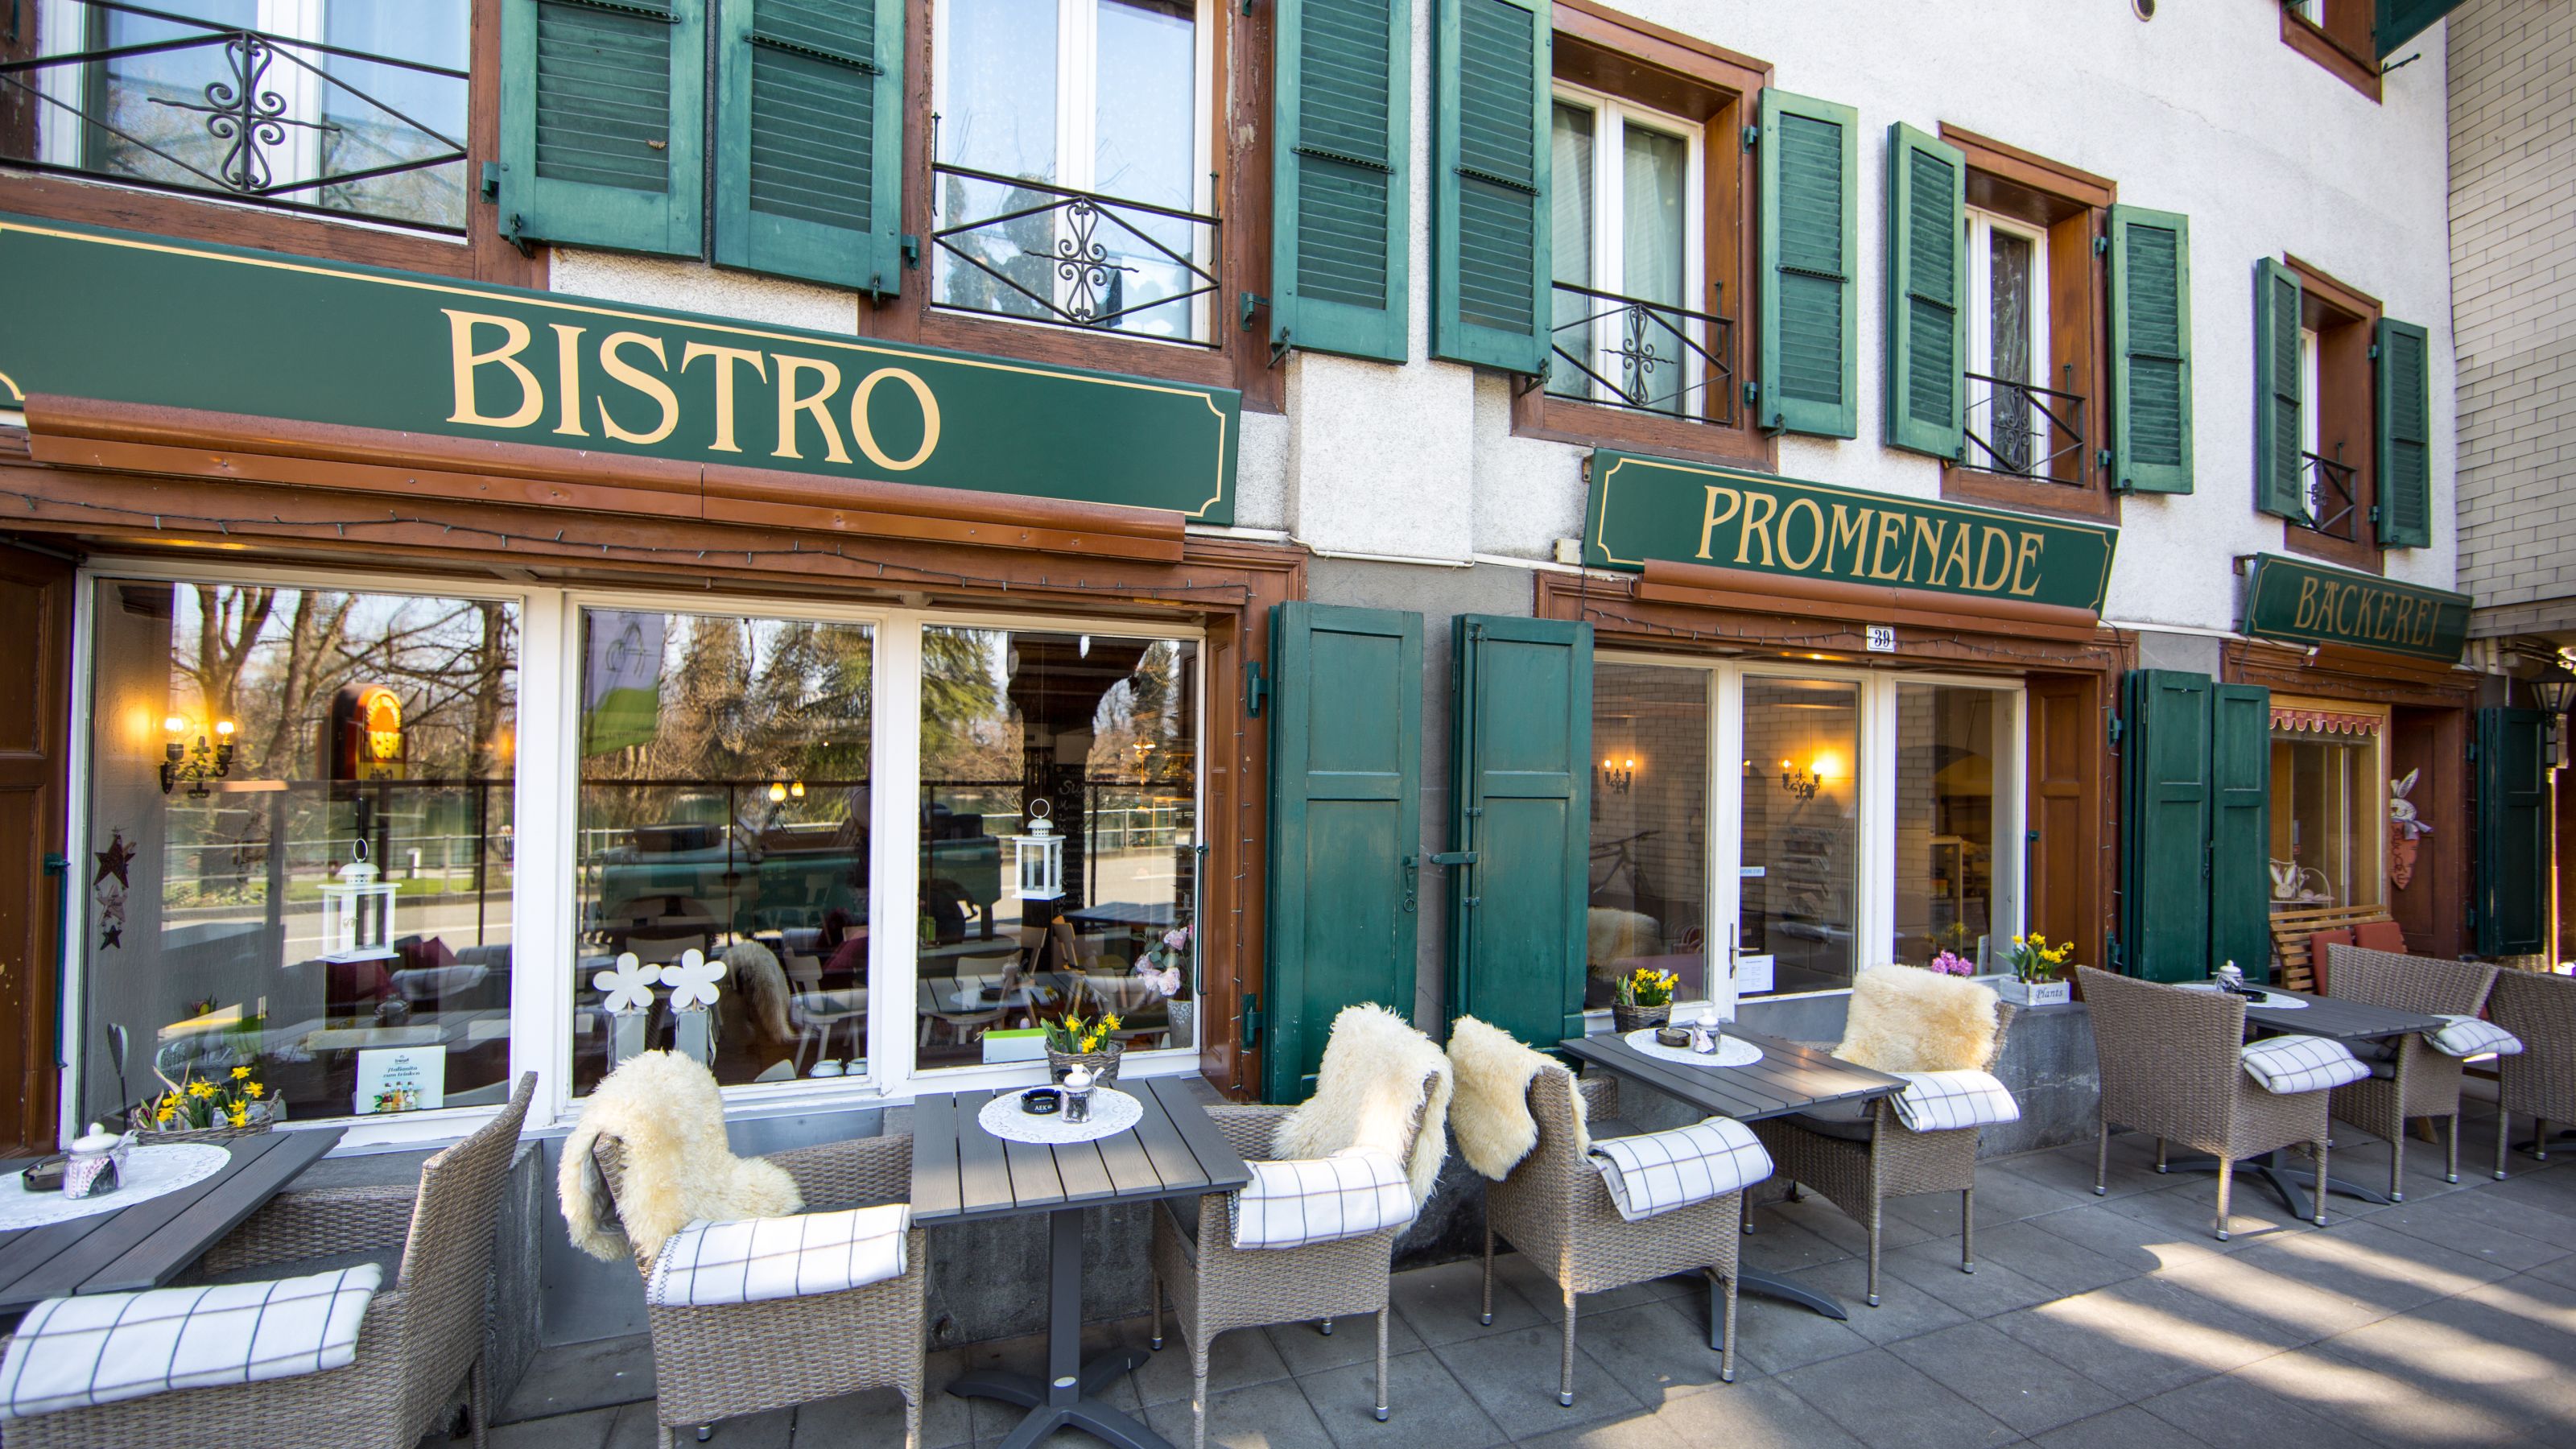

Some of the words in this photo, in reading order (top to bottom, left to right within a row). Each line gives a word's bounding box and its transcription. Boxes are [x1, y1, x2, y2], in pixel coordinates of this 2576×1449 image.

[440, 308, 940, 471] BISTRO
[1695, 485, 2045, 597] PROMENADE
[1874, 629, 1890, 648] 39
[2293, 576, 2444, 647] BÄCKEREI
[2036, 987, 2063, 999] Plants
